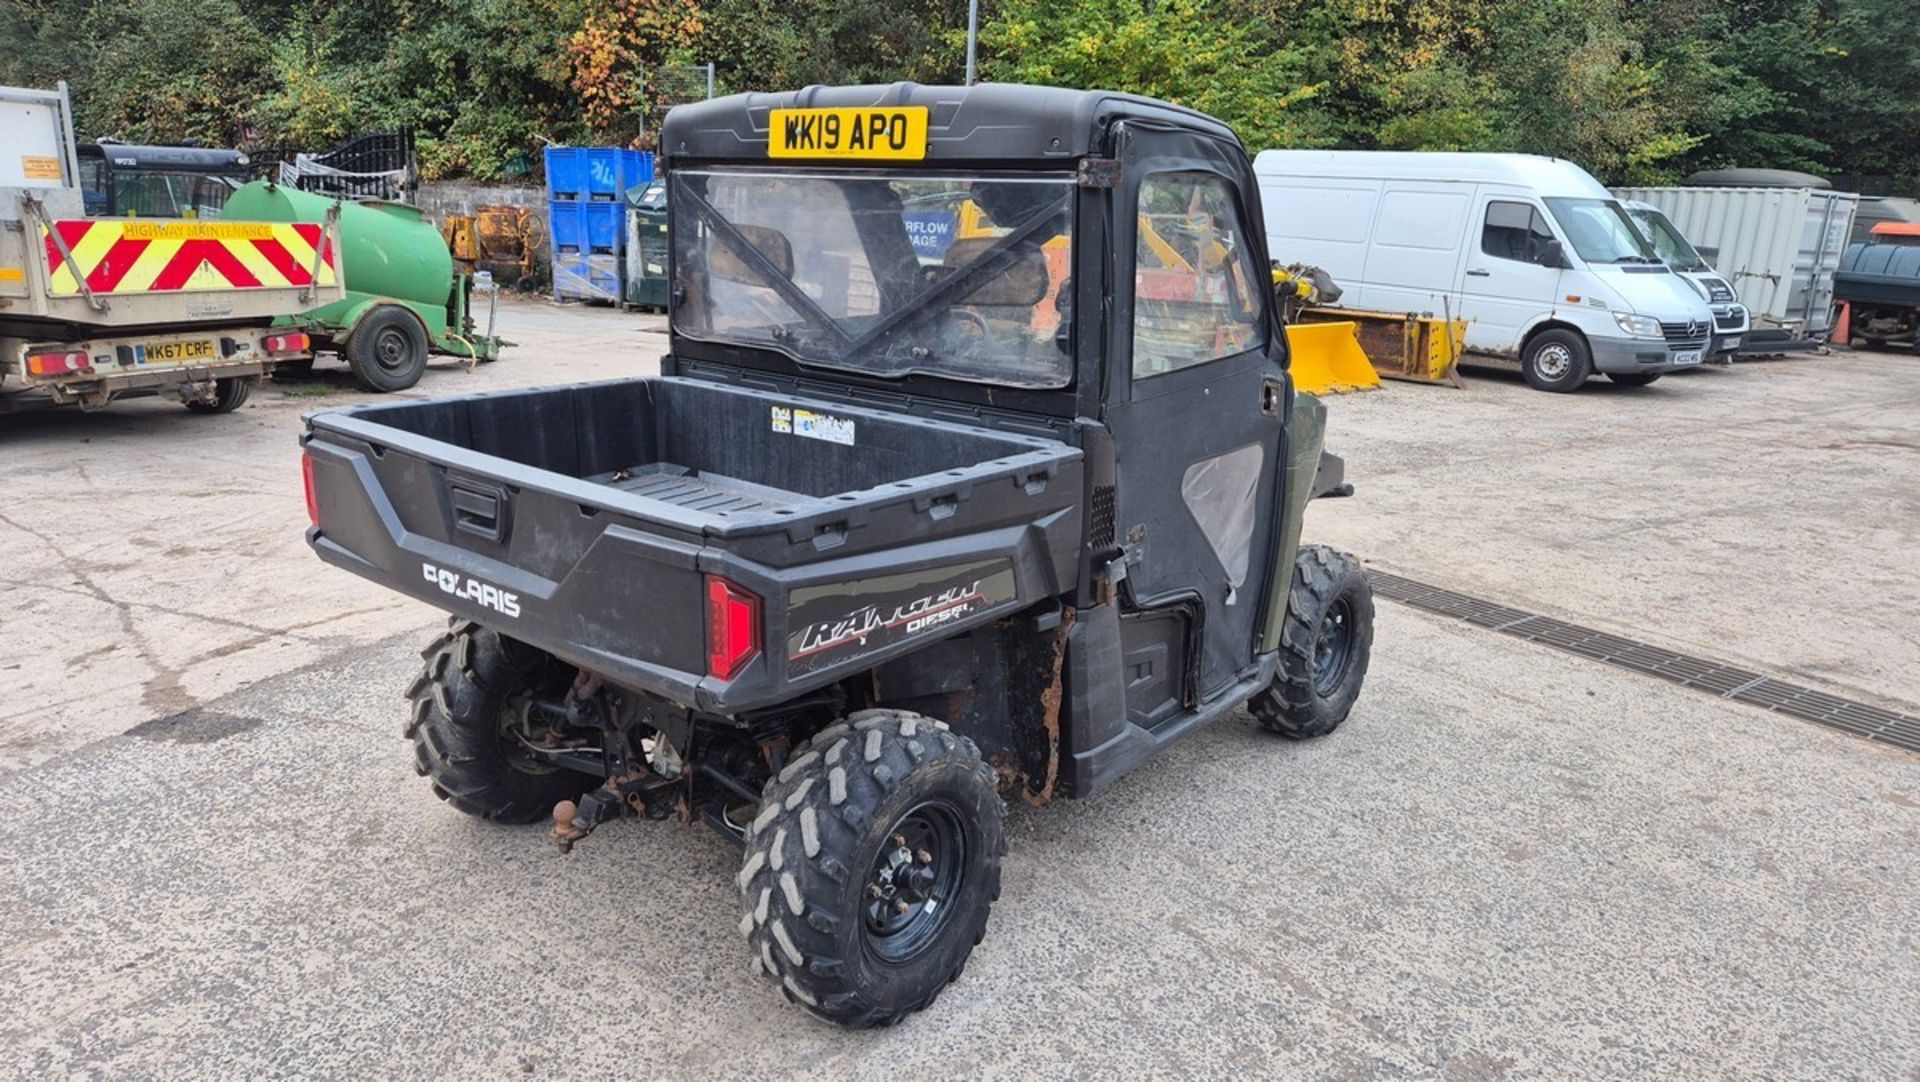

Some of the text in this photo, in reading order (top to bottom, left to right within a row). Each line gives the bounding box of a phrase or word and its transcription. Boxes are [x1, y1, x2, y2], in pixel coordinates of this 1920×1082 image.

[784, 113, 907, 151] WK19 APO
[124, 224, 271, 238] HIGHWAY MAINTENANCE
[905, 221, 948, 235] RFLOW
[909, 234, 937, 248] AGE
[145, 340, 212, 360] WK67 CRF
[422, 562, 521, 618] POLARIS
